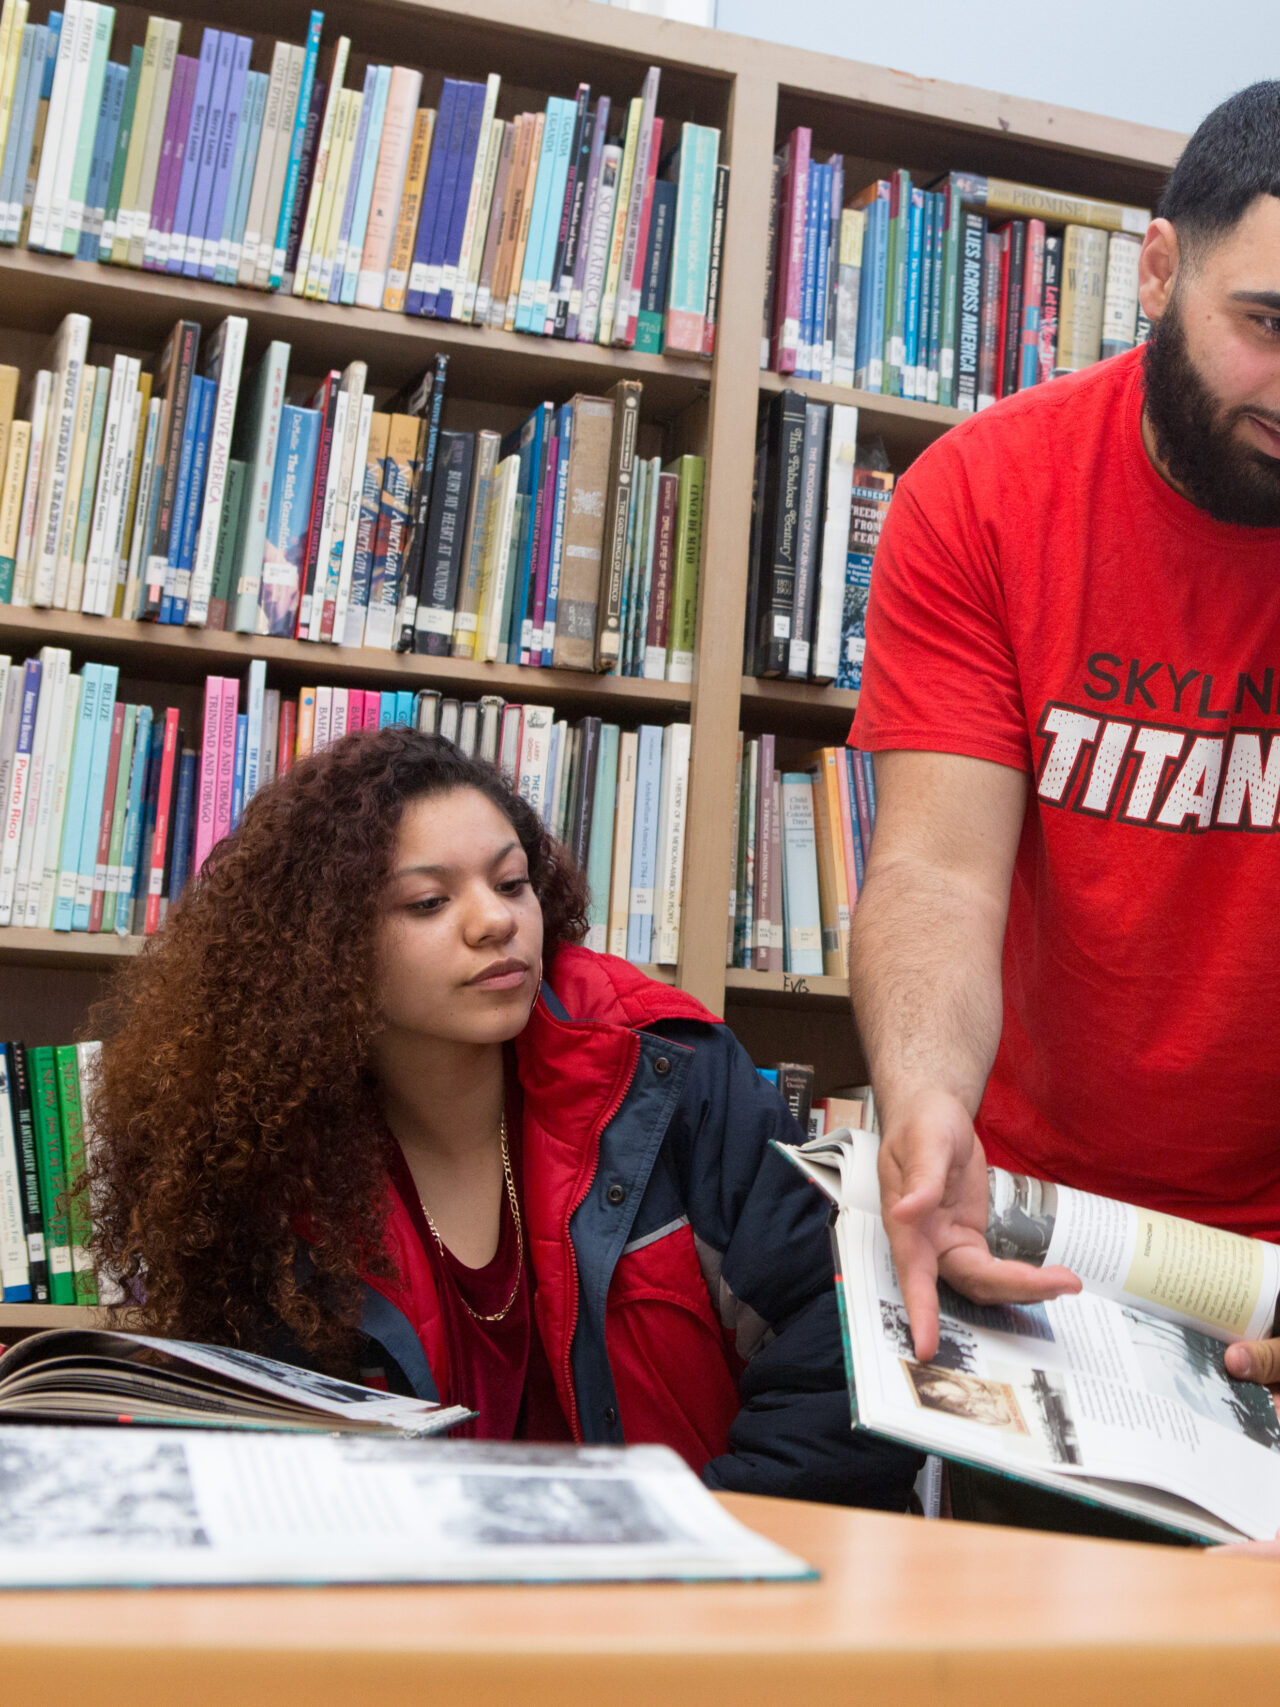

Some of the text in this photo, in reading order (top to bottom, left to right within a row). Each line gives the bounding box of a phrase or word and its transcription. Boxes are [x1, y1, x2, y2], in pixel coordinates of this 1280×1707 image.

[61, 14, 75, 60] ERITREA
[79, 17, 93, 63] ERITREA
[544, 111, 557, 154] UGANDA
[558, 115, 572, 157] UGANDA
[1012, 192, 1084, 216] PROMISE
[584, 193, 612, 310] SOUTH AFRICA
[959, 229, 981, 372] LIES ACROSS AMERICA
[216, 387, 234, 438] NATIVE
[207, 443, 226, 505] AMERICA
[283, 472, 296, 499] Sixth
[286, 453, 299, 472] The
[361, 462, 382, 509] Native
[391, 463, 412, 509] Native
[778, 427, 803, 561] This Fabulous Century
[353, 509, 375, 575] American
[384, 511, 405, 576] American
[685, 483, 698, 564] CINCO DE MAYO
[793, 608, 804, 640] HERITAG
[82, 681, 95, 720] BELIZE
[99, 682, 112, 722] BELIZE
[200, 694, 218, 823] TRINIDAD AND TOBAGO
[217, 695, 234, 823] TRINIDAD AND TOBAGO
[7, 758, 25, 839] Puerto Rico
[531, 774, 539, 791] THE
[18, 1108, 39, 1214] THE ANTISLAVERY MOVEMENT
